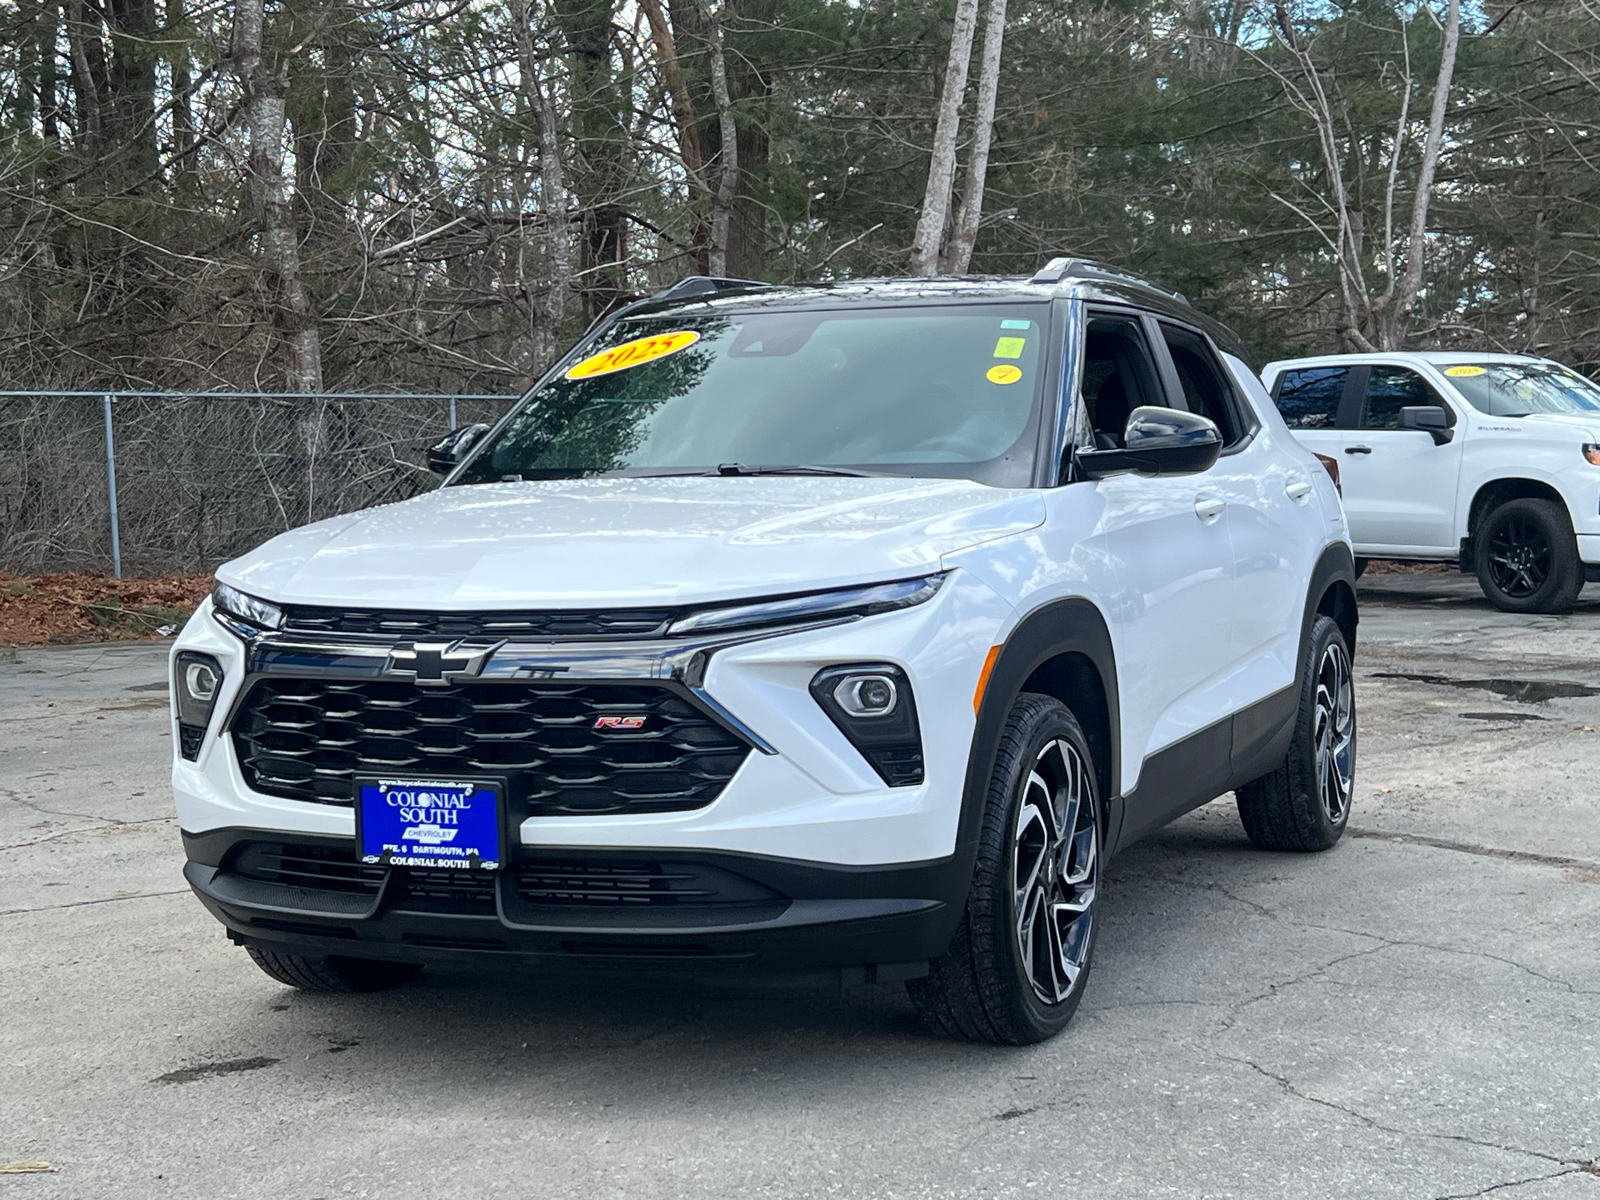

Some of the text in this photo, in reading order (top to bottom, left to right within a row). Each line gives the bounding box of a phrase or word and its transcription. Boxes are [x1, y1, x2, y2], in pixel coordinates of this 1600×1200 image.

[587, 334, 680, 374] 2025
[592, 716, 647, 729] RS
[378, 779, 474, 788] www.buycolonialsouth.com
[386, 791, 471, 809] COLONIAL
[399, 808, 458, 824] SOUTH
[408, 830, 452, 838] CHEVROLET
[401, 845, 407, 853] 6
[412, 845, 465, 857] DARTMOUTH,
[390, 856, 470, 869] COLONIAL SOUTH
